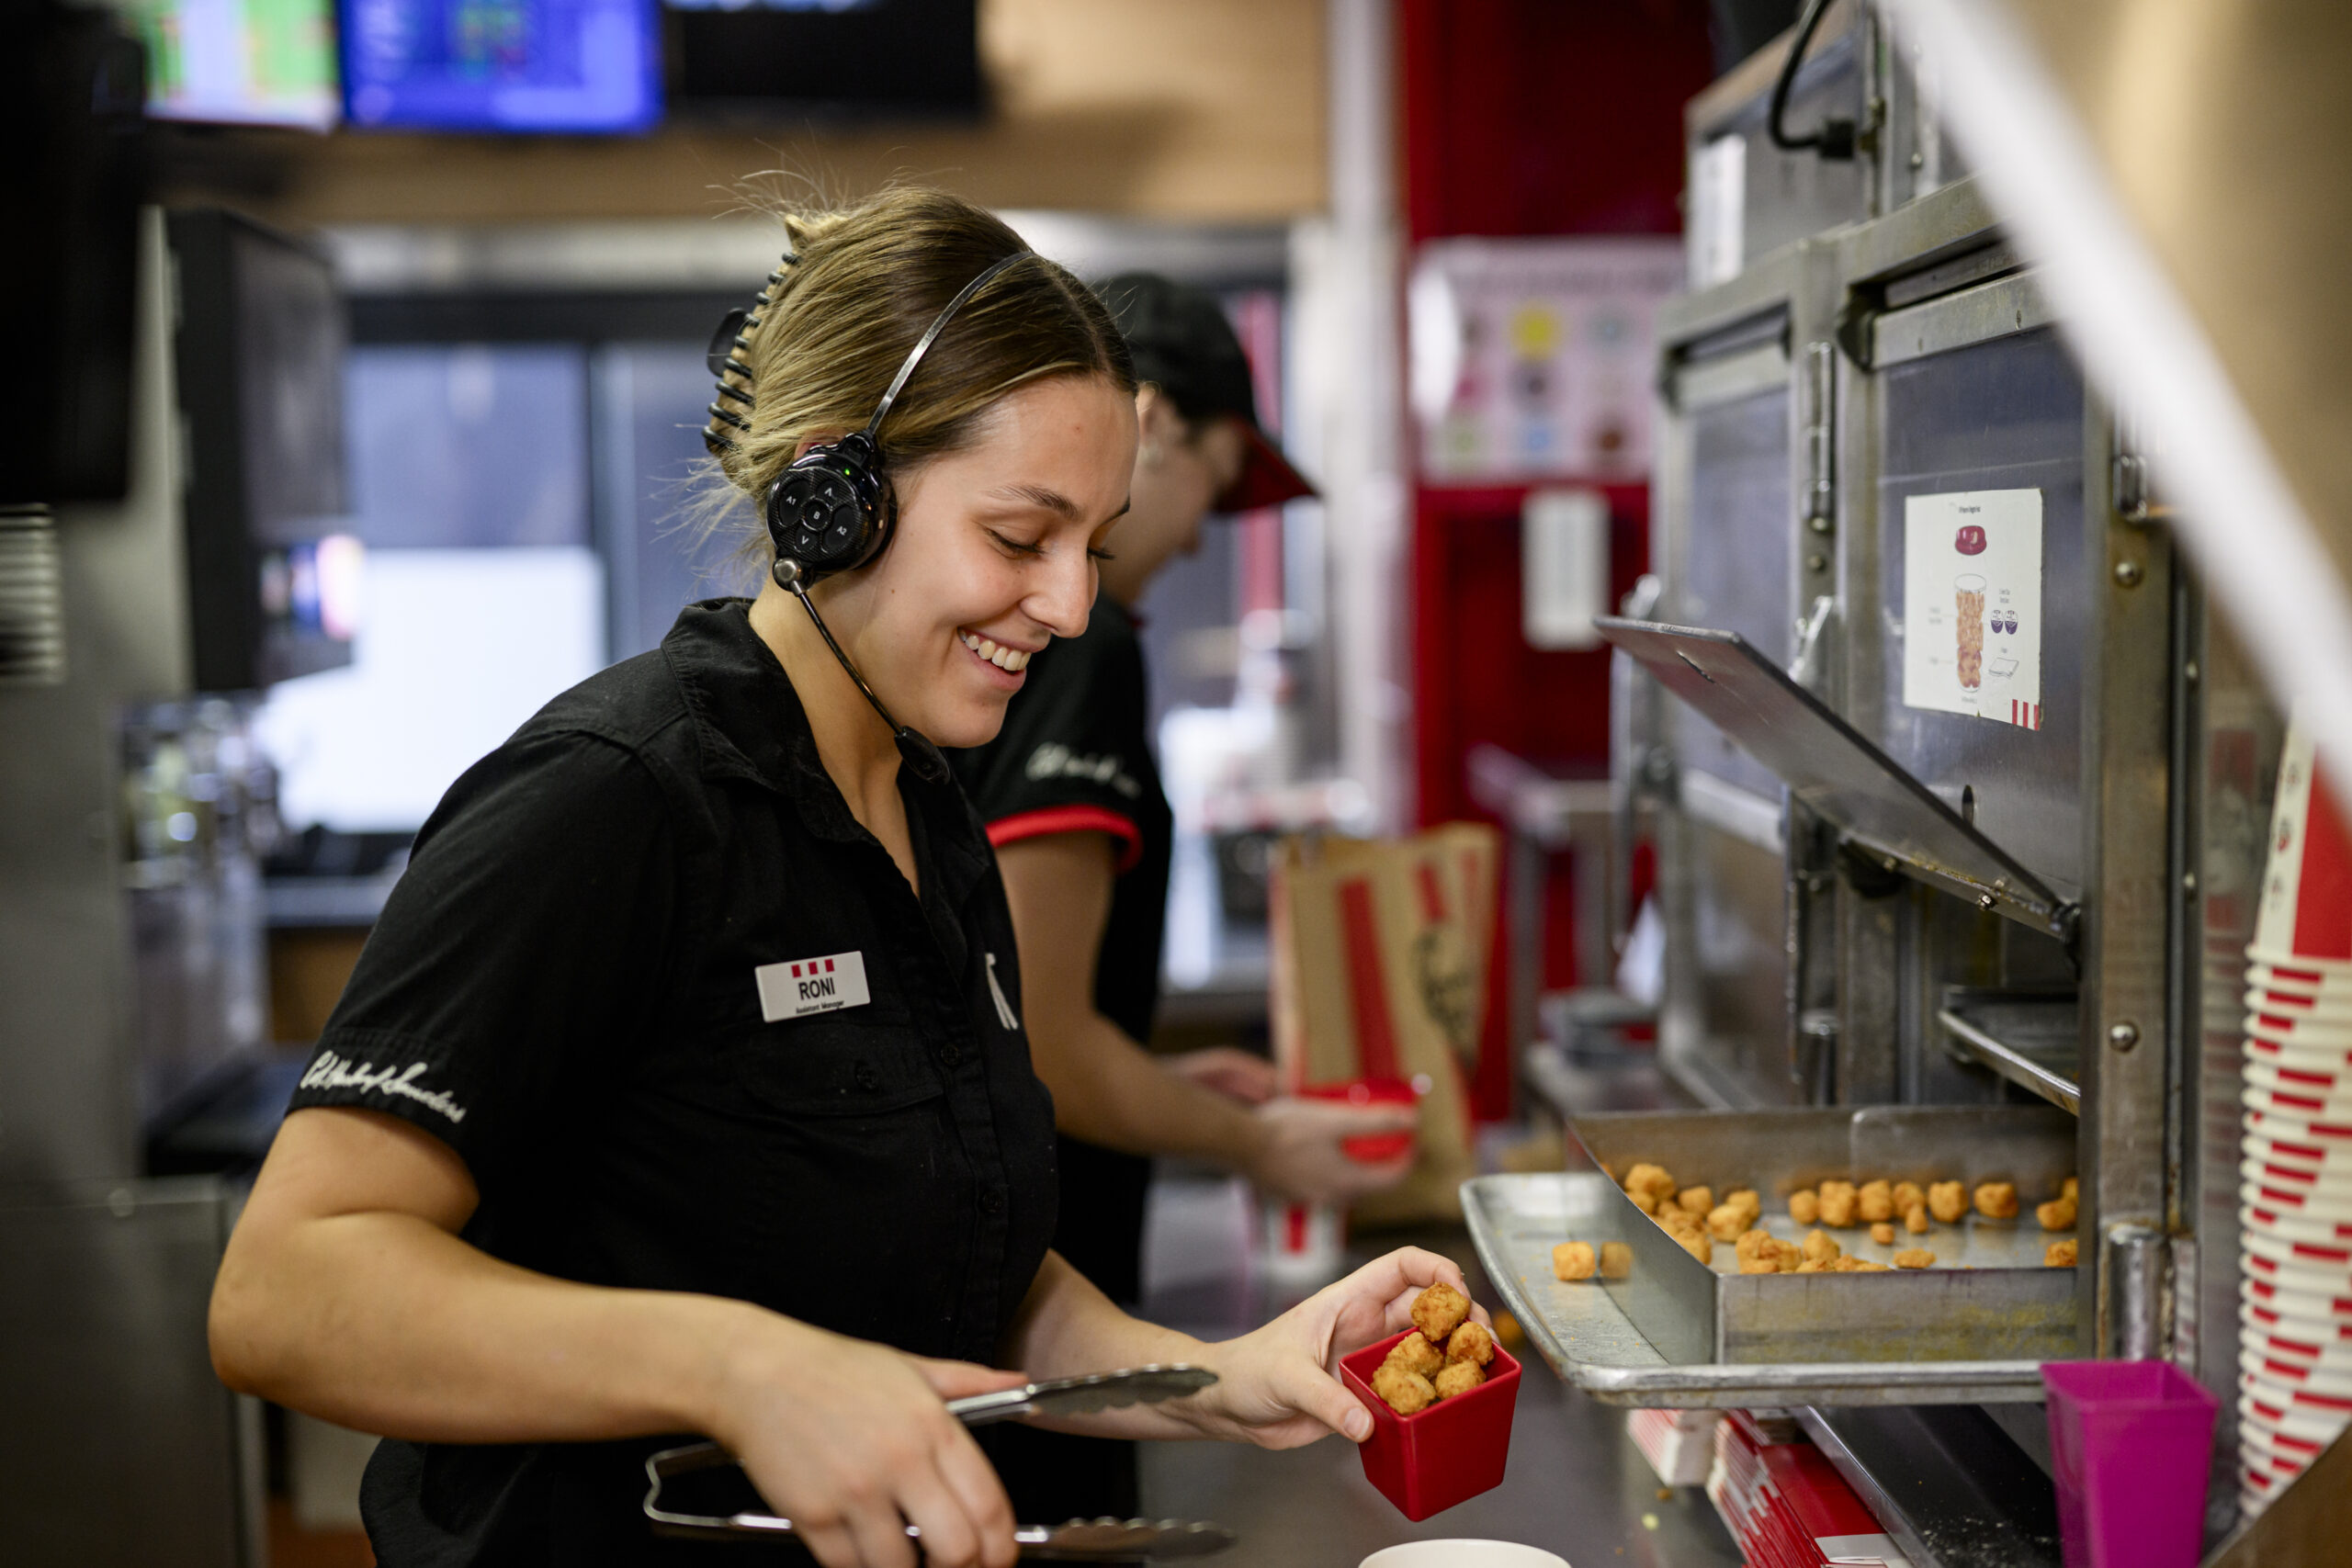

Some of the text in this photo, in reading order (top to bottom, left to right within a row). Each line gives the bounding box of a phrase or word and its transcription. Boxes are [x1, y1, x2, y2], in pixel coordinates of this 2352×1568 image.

[786, 495, 797, 505] A1
[813, 510, 820, 520] B
[836, 525, 847, 536] A2
[798, 976, 836, 1000] RONI
